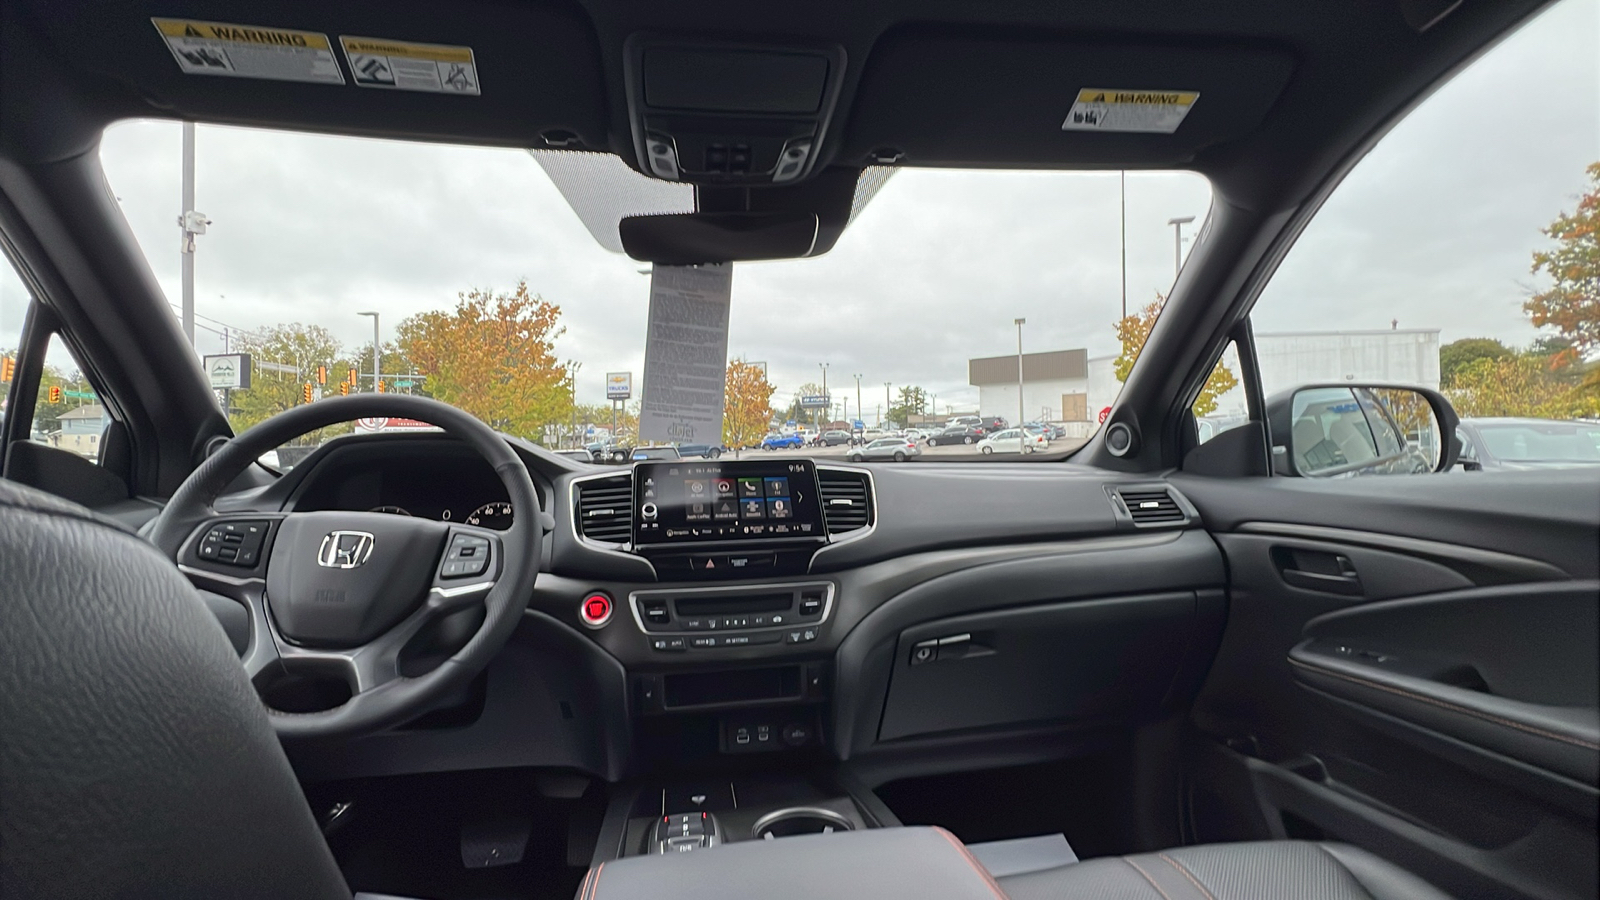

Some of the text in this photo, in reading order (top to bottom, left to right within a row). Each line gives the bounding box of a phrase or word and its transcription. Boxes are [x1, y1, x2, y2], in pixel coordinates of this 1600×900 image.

[209, 26, 307, 47] WARNING
[358, 42, 408, 54] WARNING
[1114, 93, 1180, 104] WARNING
[788, 464, 805, 473] 9:54
[442, 509, 451, 520] 0
